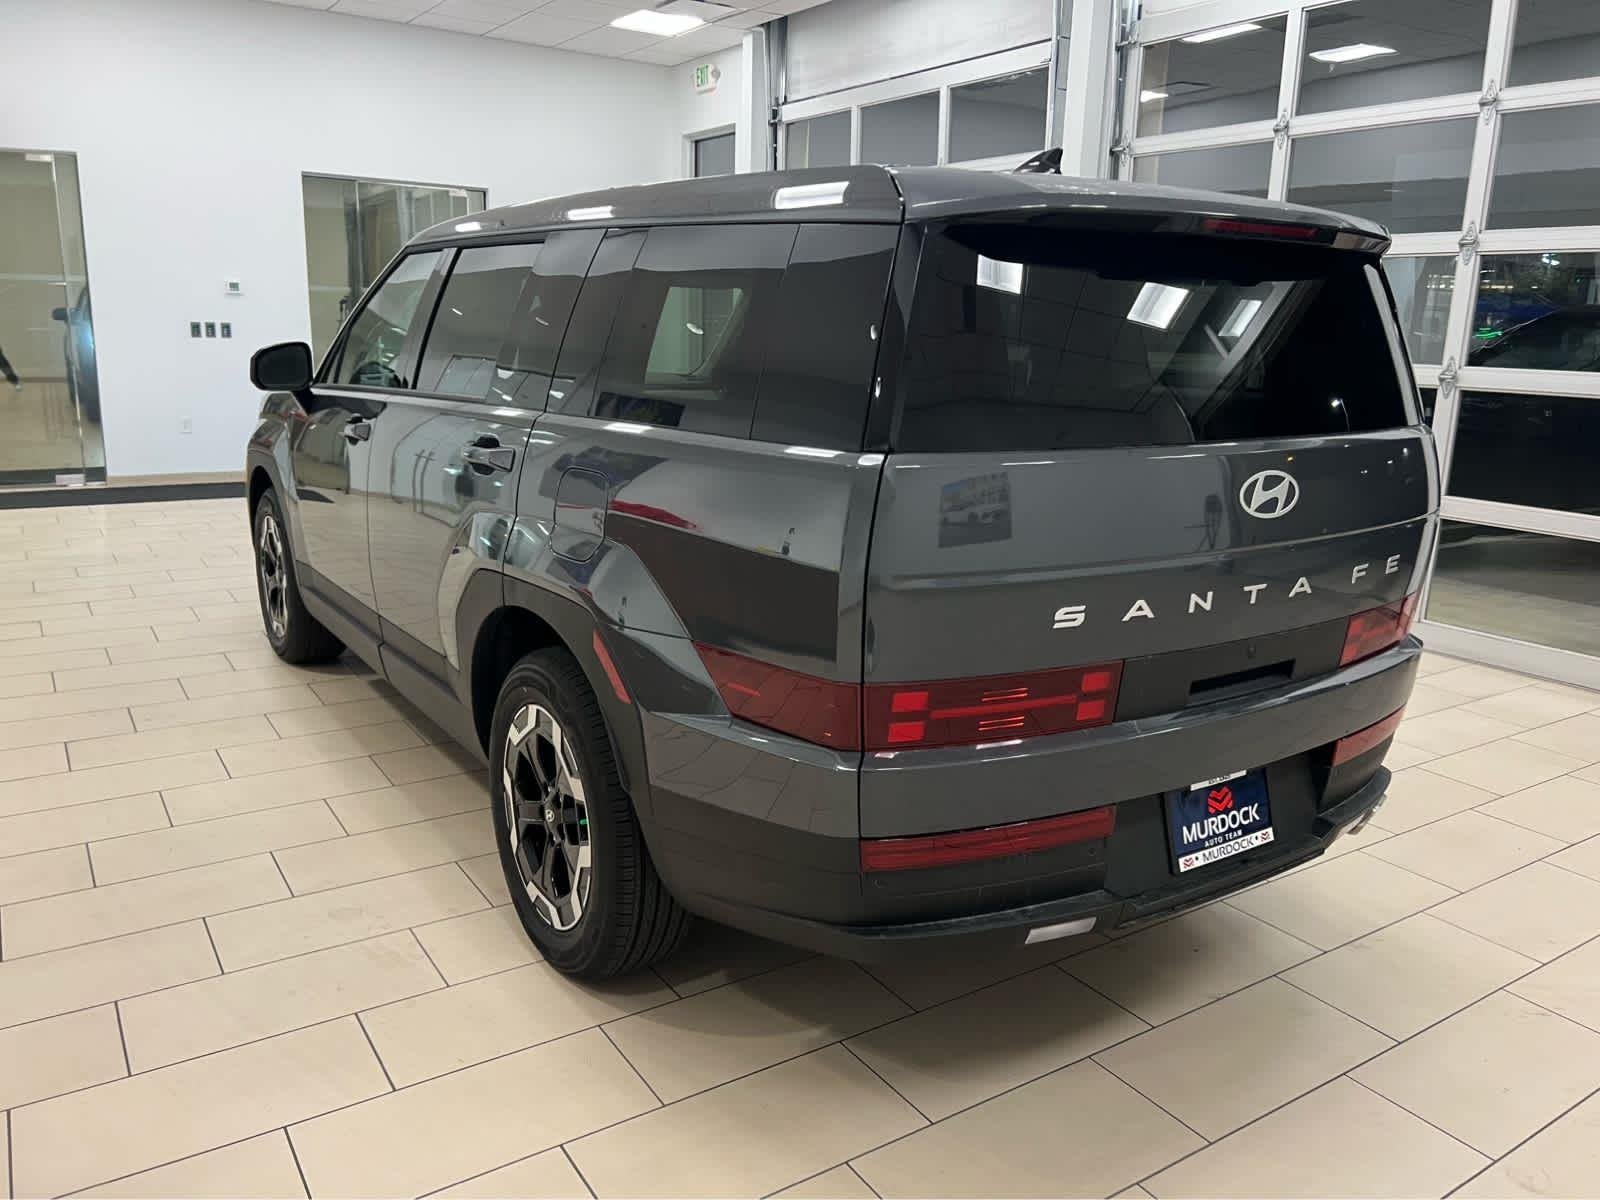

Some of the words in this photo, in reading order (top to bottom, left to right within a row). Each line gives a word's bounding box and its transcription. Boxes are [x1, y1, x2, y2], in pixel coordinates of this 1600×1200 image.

[696, 64, 709, 88] EXIT
[1052, 576, 1313, 629] SANTA
[1351, 554, 1401, 584] FE
[1182, 803, 1260, 845] MURDOCK
[1202, 836, 1255, 862] MURDOCK
[1204, 835, 1223, 848] AUTO
[1225, 829, 1243, 841] TEAM
